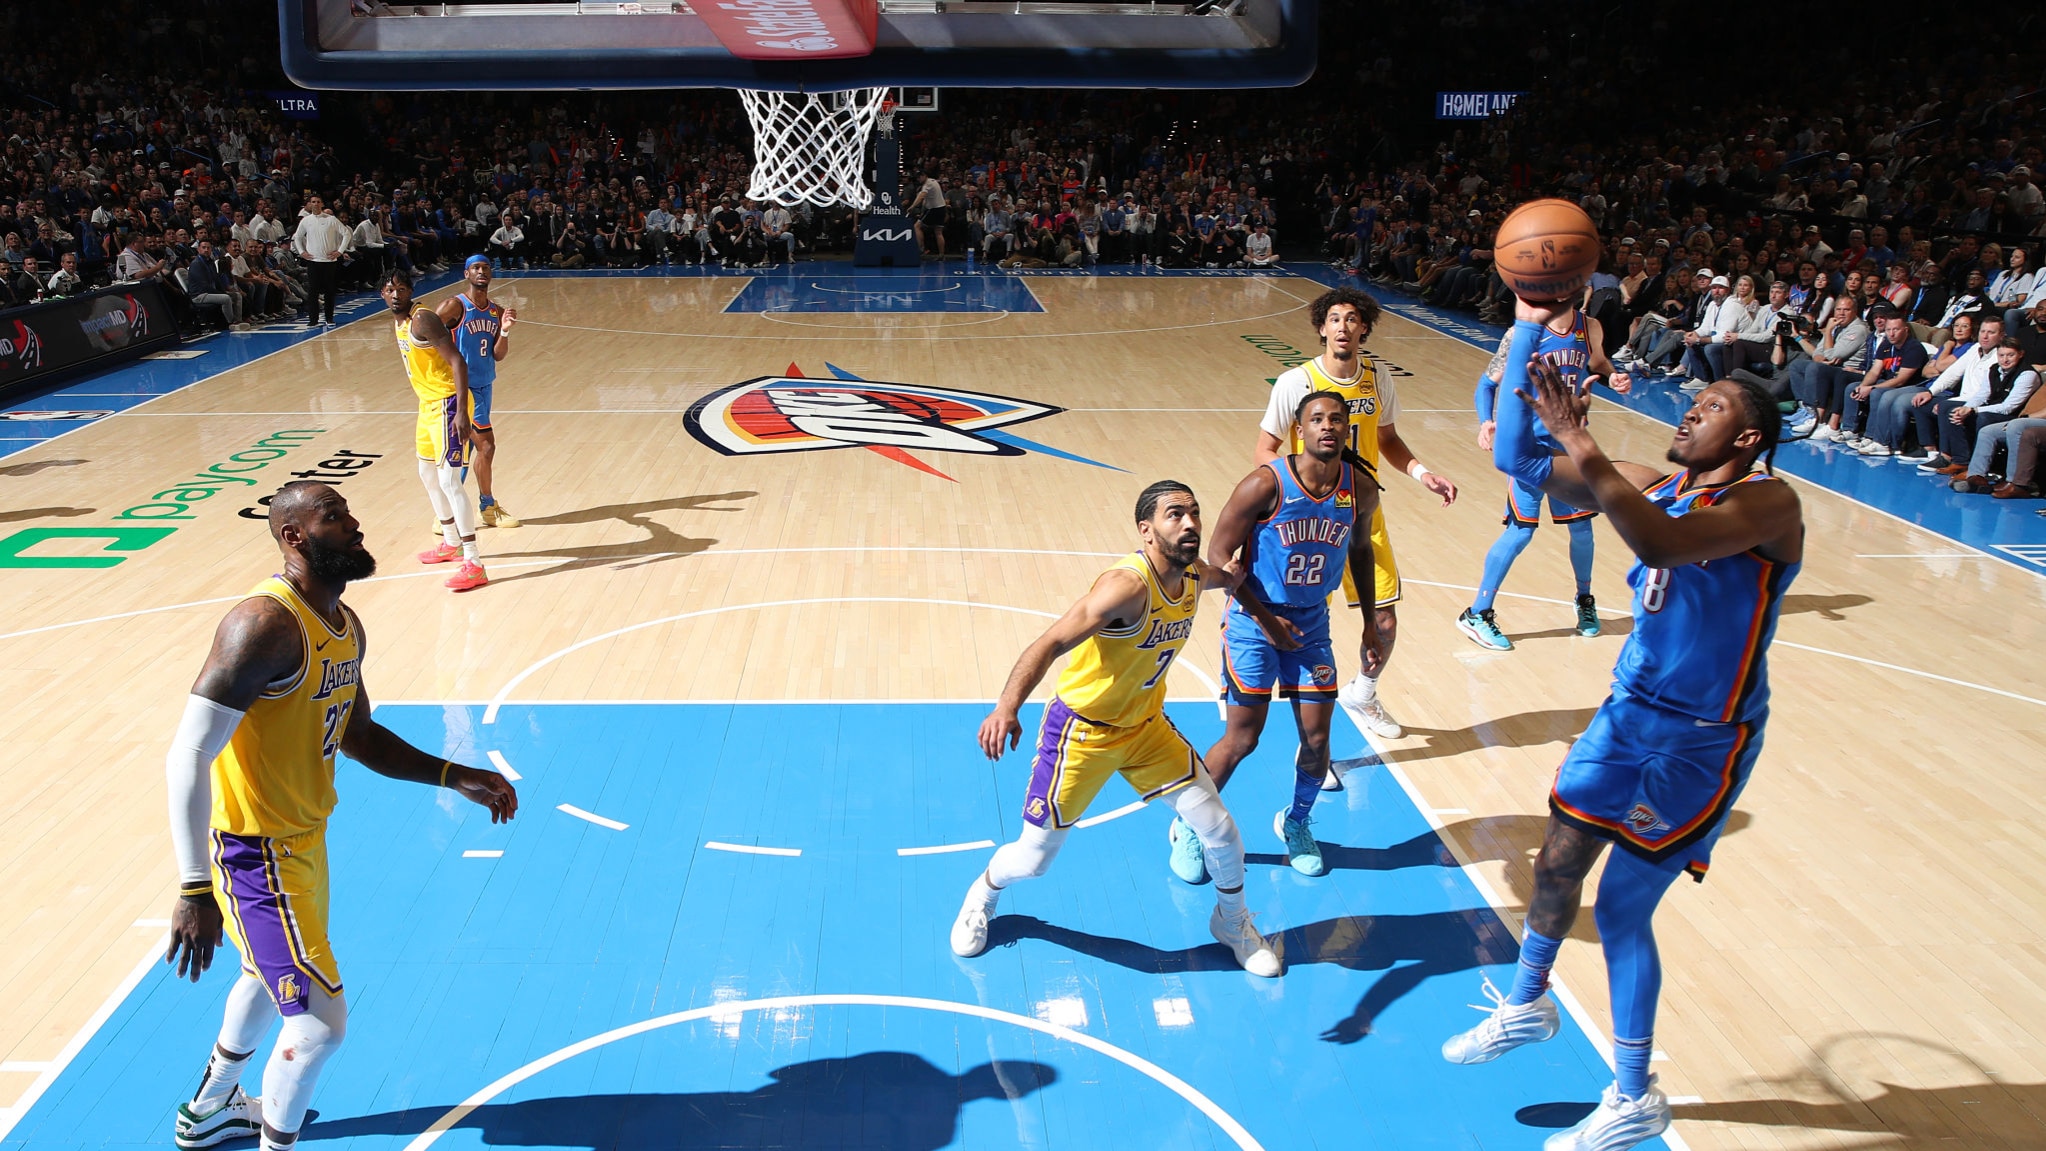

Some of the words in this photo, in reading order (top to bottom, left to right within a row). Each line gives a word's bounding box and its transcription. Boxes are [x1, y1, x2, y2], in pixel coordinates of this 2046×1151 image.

[276, 99, 317, 111] LTRA
[873, 206, 901, 215] Health
[480, 338, 488, 357] 2
[1240, 335, 1314, 367] ycom
[1540, 350, 1586, 369] UNDER
[1346, 397, 1376, 416] ERS
[111, 429, 328, 520] paycom
[238, 449, 383, 520] cter
[1274, 518, 1350, 547] THUNDER
[1286, 553, 1326, 585] 22
[1643, 568, 1671, 613] 8
[1141, 648, 1176, 690] 7
